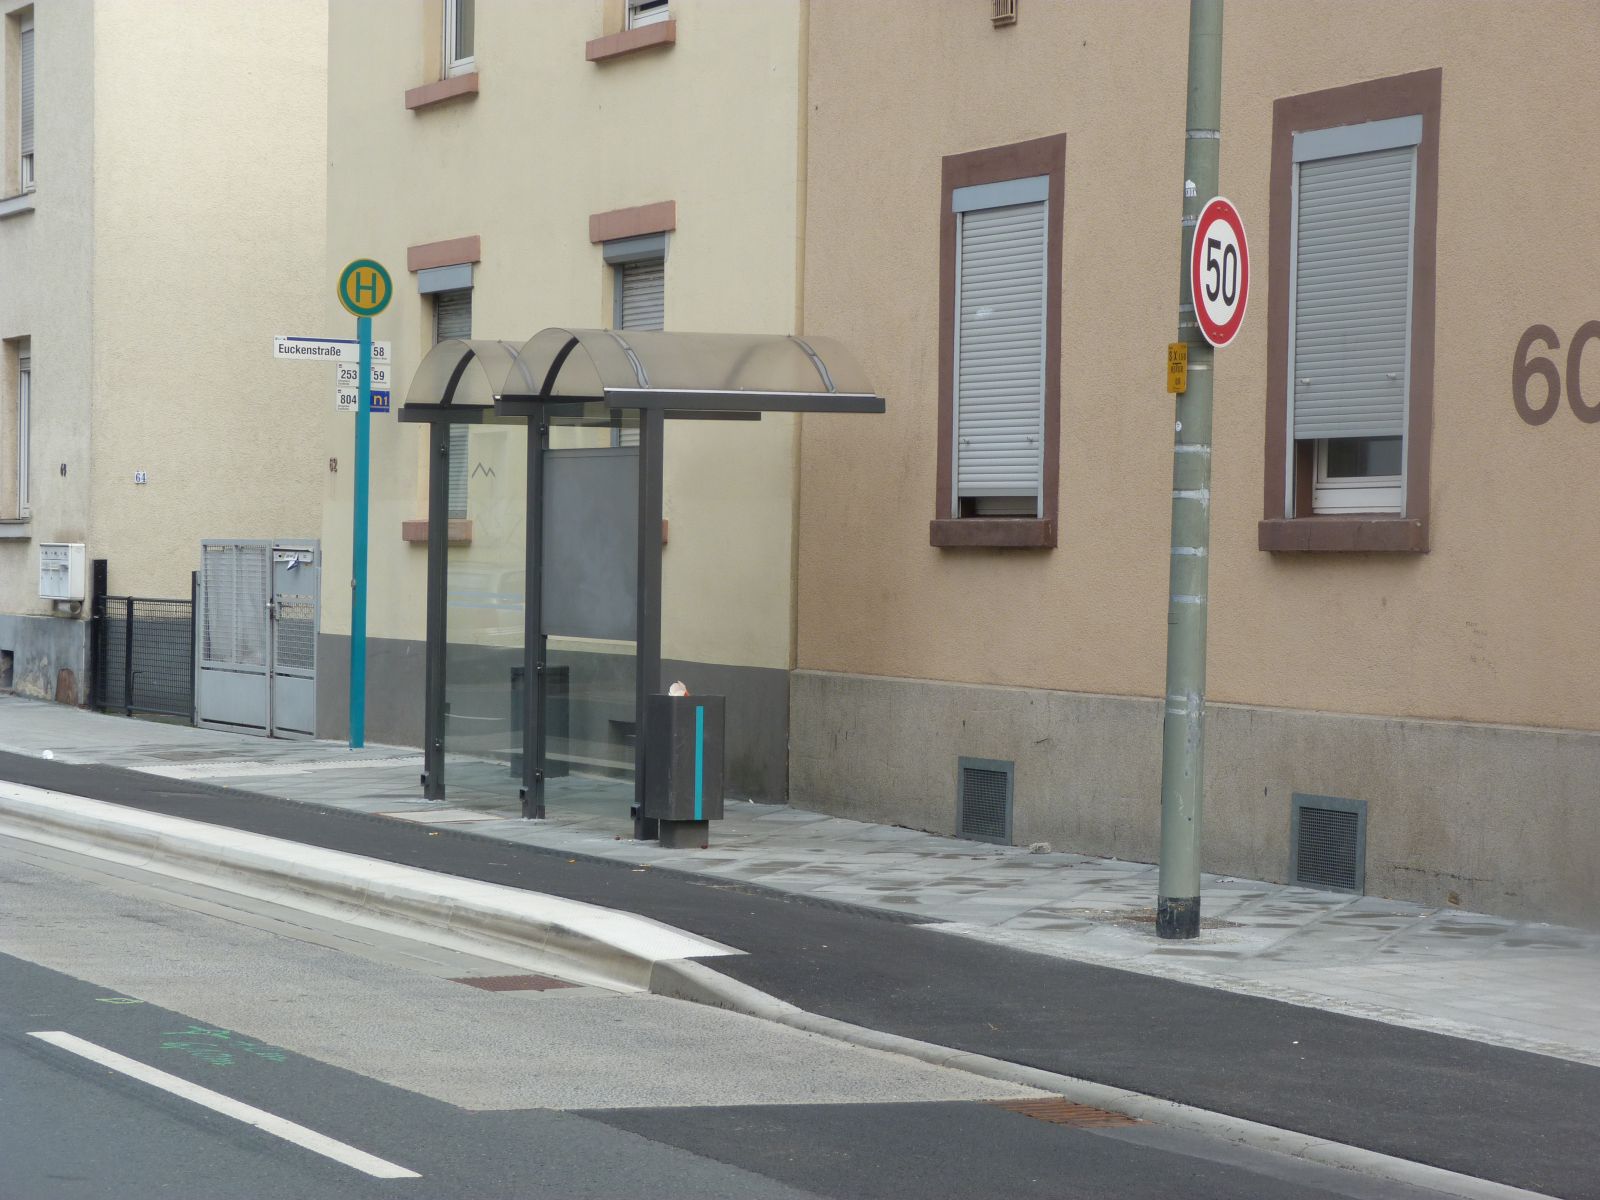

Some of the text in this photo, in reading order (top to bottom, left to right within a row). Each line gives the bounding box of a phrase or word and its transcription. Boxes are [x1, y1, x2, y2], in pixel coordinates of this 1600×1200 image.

[1206, 237, 1237, 306] 50
[355, 271, 377, 304] H
[278, 343, 341, 357] Euckenstraße
[373, 347, 385, 357] 58
[341, 369, 358, 380] 253
[373, 371, 385, 381] 59
[340, 394, 357, 405] 804
[373, 395, 388, 406] n1
[135, 472, 146, 483] 64
